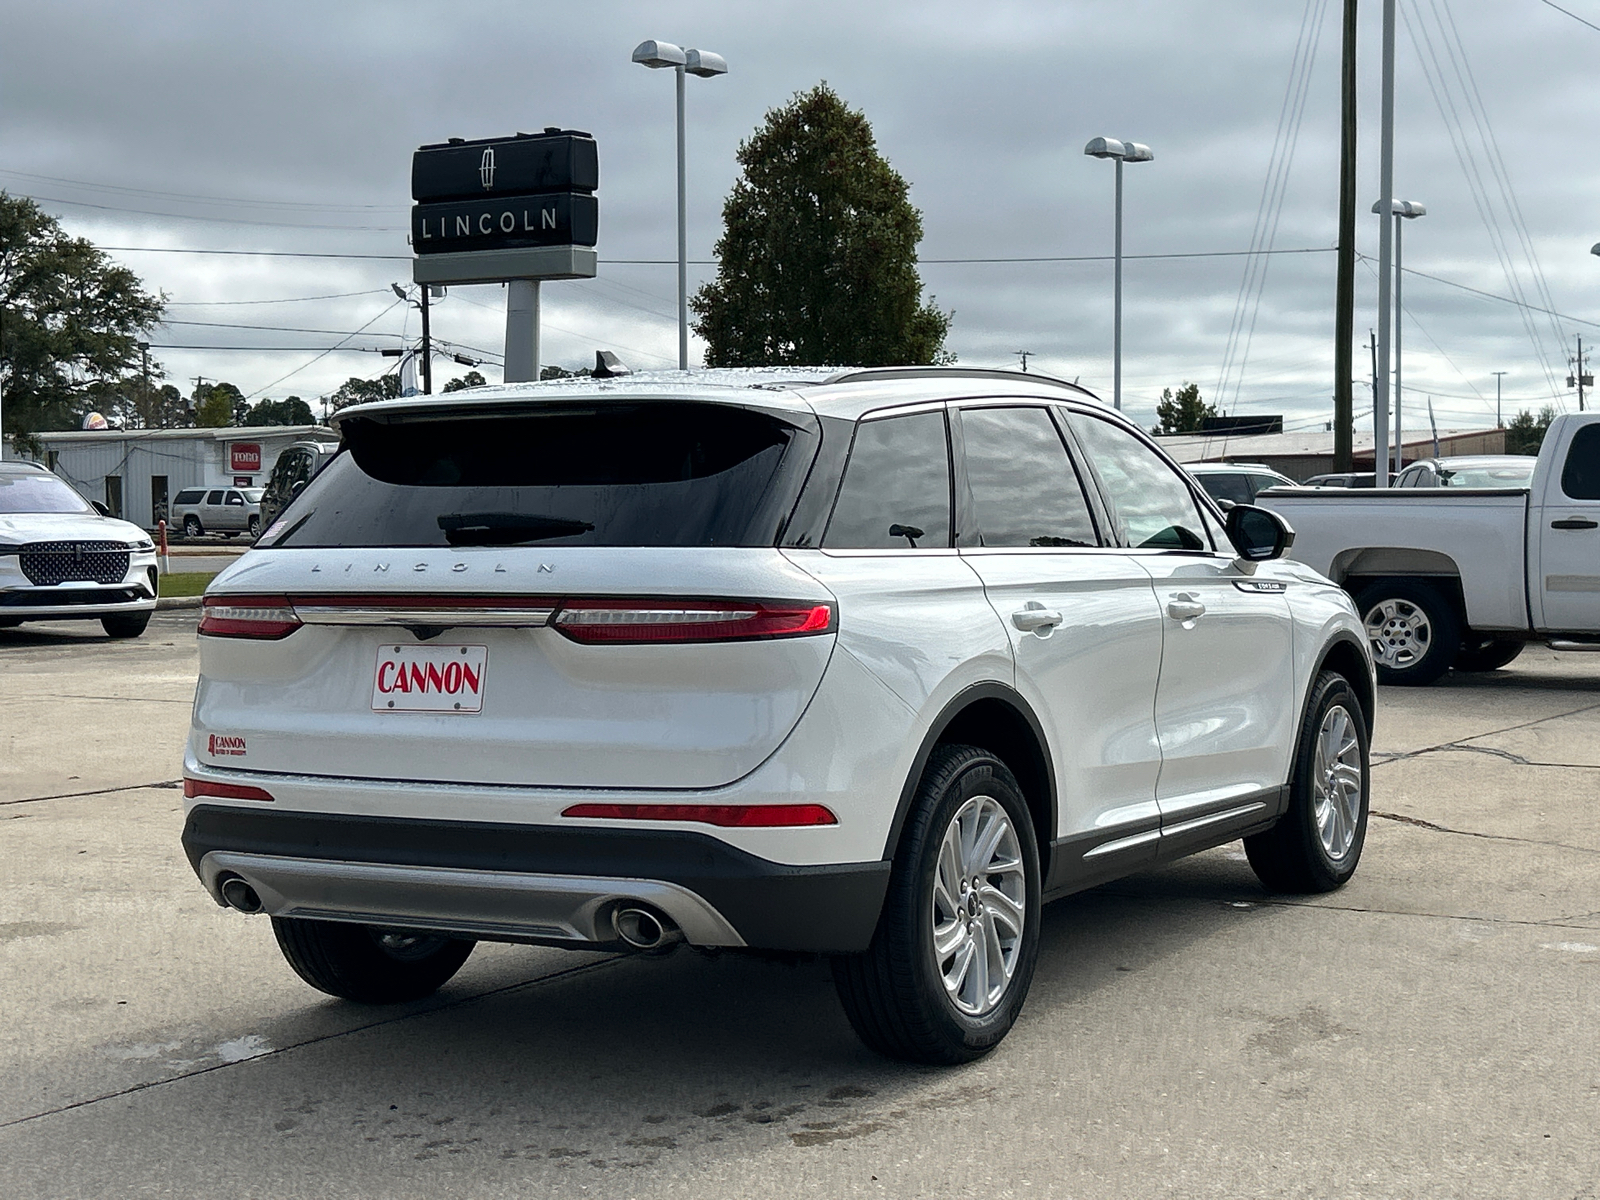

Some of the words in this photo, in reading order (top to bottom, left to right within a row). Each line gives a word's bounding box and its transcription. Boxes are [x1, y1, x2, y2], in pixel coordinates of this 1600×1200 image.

[422, 208, 556, 239] LINCOLN
[232, 452, 259, 463] TORO
[311, 562, 556, 574] LINCOLN
[377, 661, 482, 695] CANNON
[215, 736, 246, 749] CANNON
